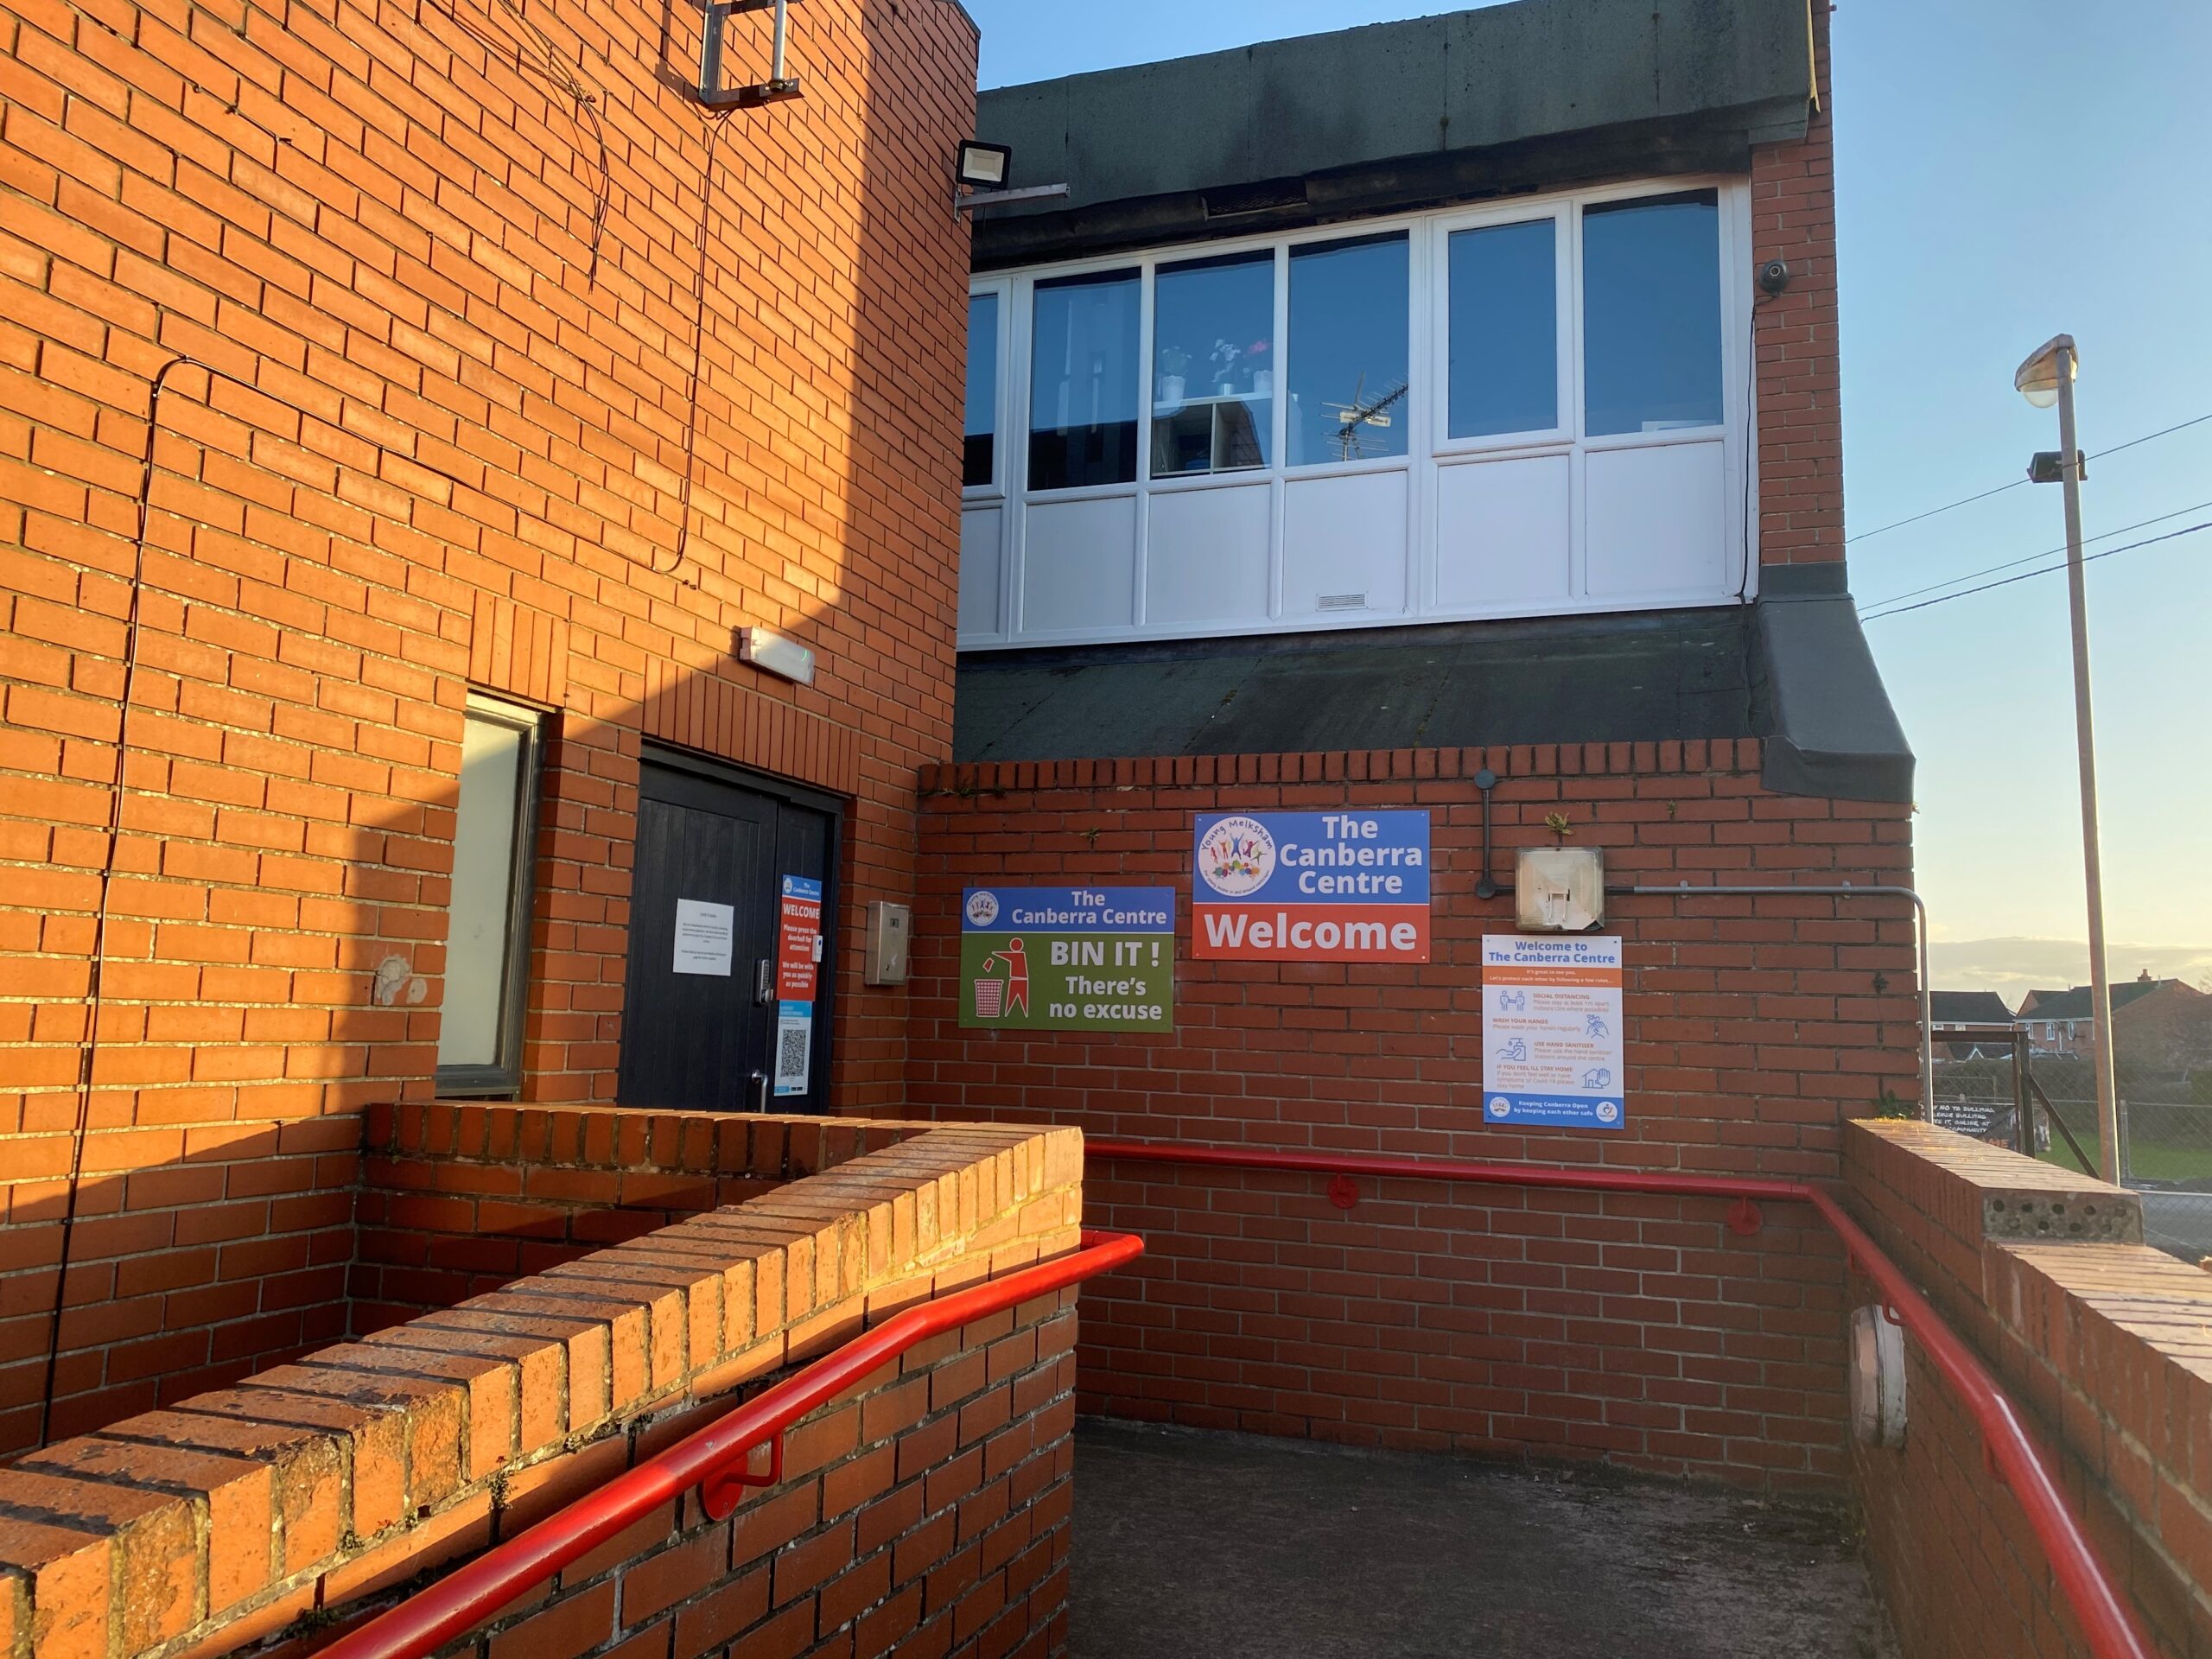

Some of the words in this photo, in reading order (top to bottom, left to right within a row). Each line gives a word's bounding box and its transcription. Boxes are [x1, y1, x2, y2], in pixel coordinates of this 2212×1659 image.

[1201, 826, 1227, 851] Young
[1229, 820, 1273, 849] Melksham
[1322, 815, 1378, 839] The
[1280, 842, 1422, 867] Canberra
[1299, 871, 1403, 894] Centre
[1071, 890, 1105, 906] The
[783, 903, 820, 919] WELCOME
[1012, 908, 1097, 925] Canberra
[1102, 909, 1166, 925] Centre
[1204, 912, 1417, 950] Welcome
[1051, 941, 1104, 966] BIN
[1115, 942, 1142, 966] IT
[1151, 942, 1160, 967] !
[1515, 941, 1571, 951] Welcome
[1575, 943, 1588, 951] to
[1489, 952, 1510, 962] The
[1514, 953, 1570, 963] Canberra
[1573, 953, 1615, 963] Centre
[1065, 976, 1147, 996] There's
[1050, 1002, 1077, 1018] no
[1084, 1003, 1162, 1020] excuse
